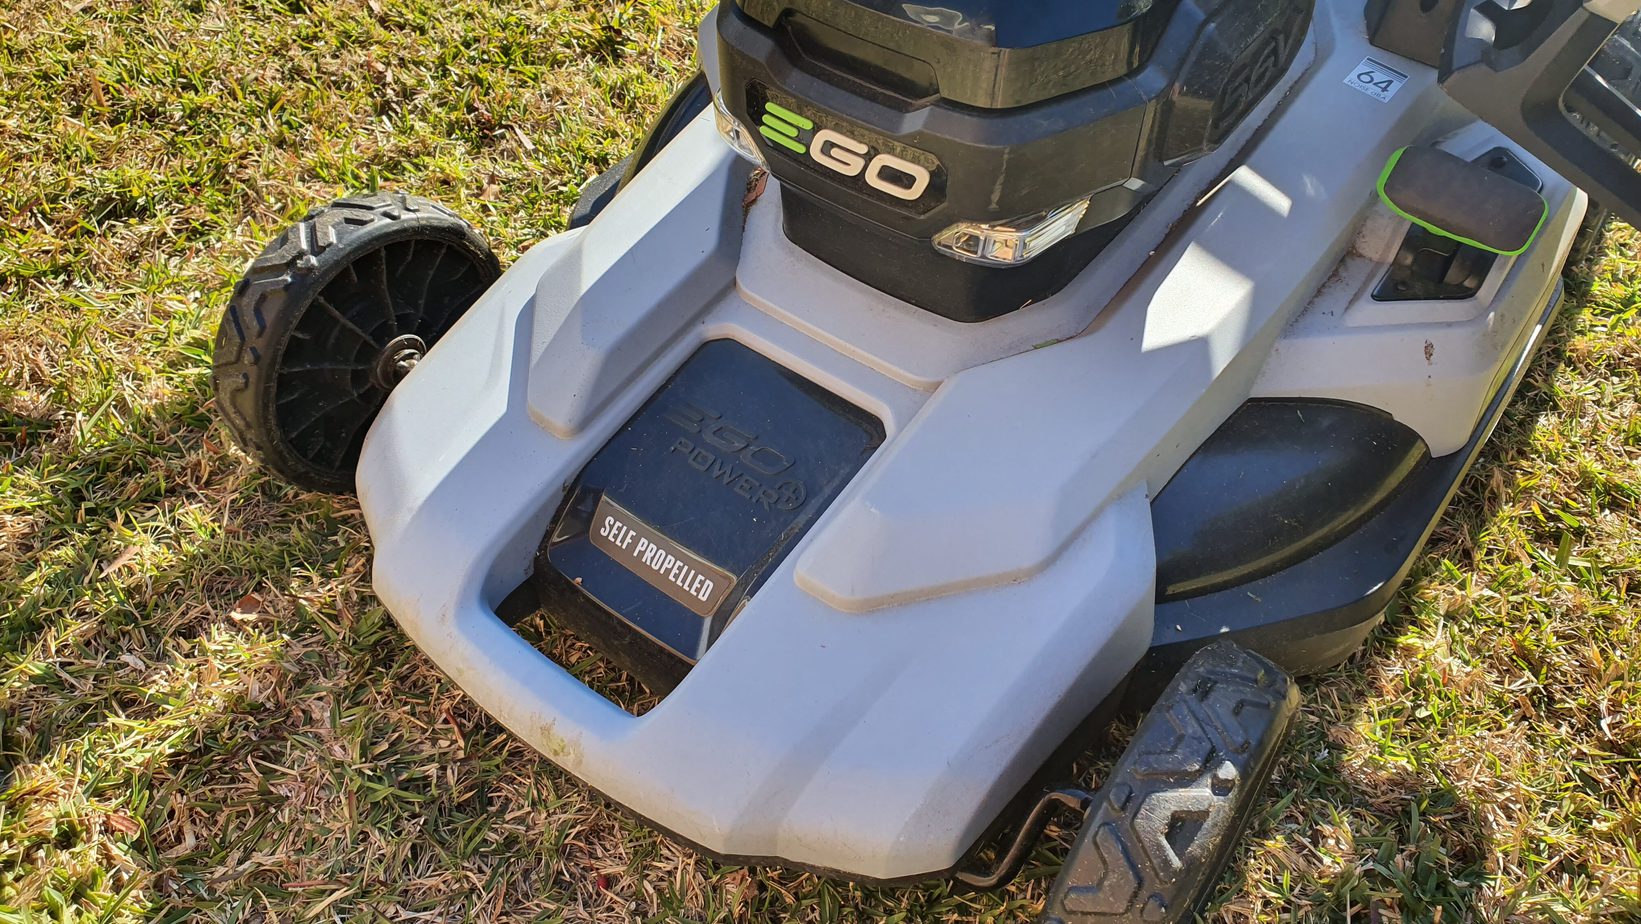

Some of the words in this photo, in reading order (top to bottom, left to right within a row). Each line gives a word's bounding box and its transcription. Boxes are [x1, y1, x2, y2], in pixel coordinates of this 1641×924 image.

[1356, 70, 1394, 92] 64
[759, 101, 931, 200] EGO
[664, 402, 796, 475] EGO
[600, 515, 637, 550] SELF
[633, 537, 714, 602] PROPELLED
